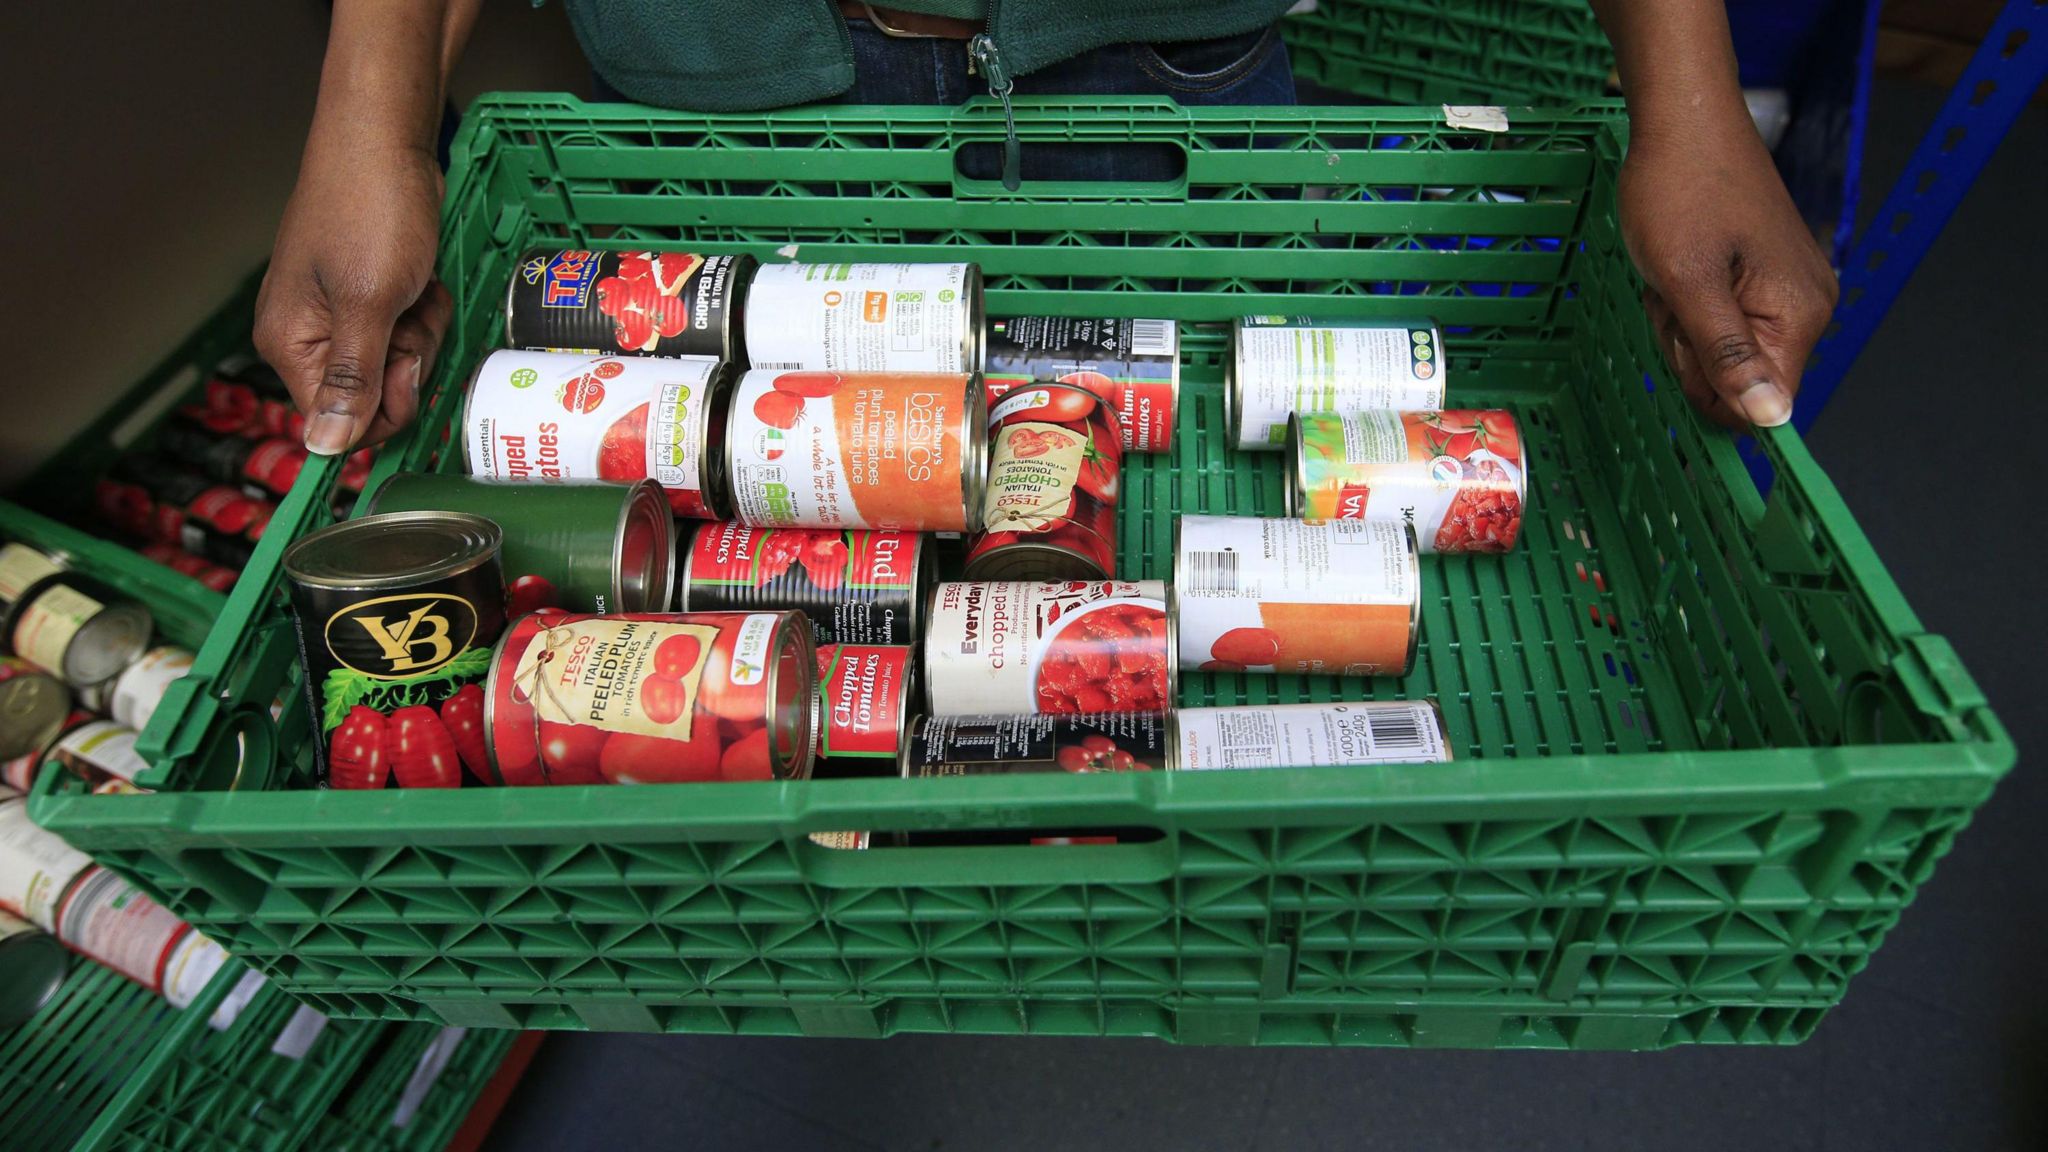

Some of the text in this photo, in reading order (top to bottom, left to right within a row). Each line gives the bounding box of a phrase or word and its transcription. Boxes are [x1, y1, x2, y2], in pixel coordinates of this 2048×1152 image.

[547, 250, 592, 304] TRS
[712, 267, 727, 297] TOMATO
[695, 277, 712, 330] CHOPPED
[711, 298, 721, 309] IN
[822, 309, 833, 369] sainsburys.co.uk
[1081, 326, 1092, 342] 400g
[1119, 389, 1134, 425] Plum
[1135, 397, 1151, 451] Tomatoes
[1154, 408, 1164, 425] Juice
[479, 418, 492, 469] essentials
[813, 425, 822, 434] a
[848, 389, 868, 484] in tomato juice
[868, 389, 884, 486] plum tomatoes
[883, 410, 897, 460] peeled
[908, 392, 942, 482] basics
[932, 406, 946, 466] Sainsbury's
[812, 438, 826, 471] whole
[826, 457, 836, 466] A
[1006, 467, 1051, 475] TOMATOES
[1045, 461, 1060, 470] rich
[813, 475, 828, 489] lot
[826, 470, 837, 490] little
[995, 473, 1061, 488] CHOPPED
[1005, 484, 1042, 493] ITALIAN
[815, 492, 829, 504] of
[997, 497, 1041, 508] TESCO
[715, 519, 739, 564] matoes
[872, 539, 899, 578] End
[595, 595, 606, 616] UICE
[943, 583, 958, 611] TESCO
[961, 586, 984, 655] Everyday
[988, 594, 1009, 670] chopped
[1010, 603, 1019, 634] Produced
[1019, 620, 1028, 666] No artificial
[560, 635, 591, 686] TESCO
[583, 642, 609, 686] ITALIAN
[589, 623, 640, 722] PEELED PLUM
[612, 640, 641, 697] TOMATOES
[629, 652, 647, 685] tomato
[623, 687, 636, 706] rich
[834, 656, 860, 728] Chopped
[853, 653, 880, 733] Tomatoes
[878, 662, 893, 720] in Tomato Juice
[620, 707, 631, 718] in
[1352, 714, 1367, 738] 240g
[1186, 729, 1198, 749] Juice
